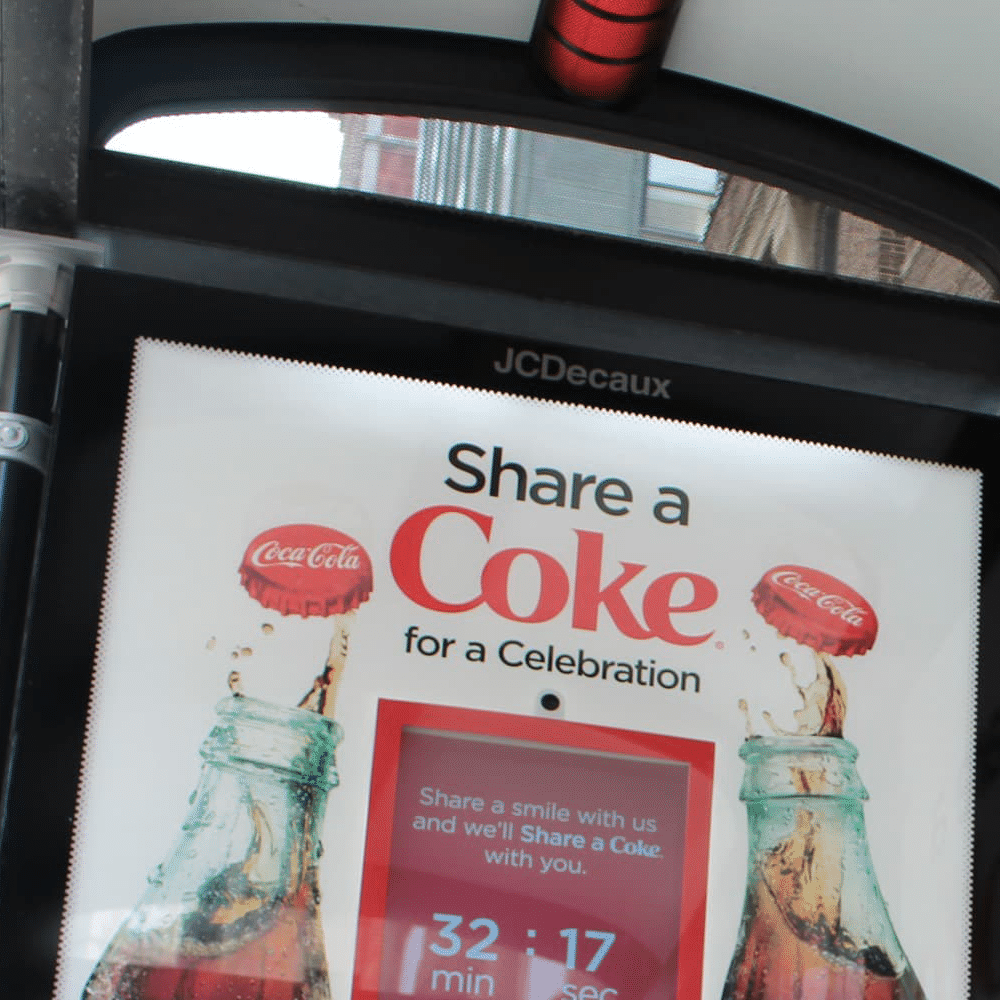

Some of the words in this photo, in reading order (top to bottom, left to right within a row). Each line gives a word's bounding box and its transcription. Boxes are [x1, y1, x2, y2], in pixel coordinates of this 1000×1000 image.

[493, 346, 671, 400] JCDecaux
[444, 442, 633, 517] Share
[652, 486, 691, 526] a
[389, 504, 718, 647] Coke
[404, 626, 457, 659] for
[464, 641, 487, 664] a
[498, 639, 701, 693] Celebration
[412, 814, 457, 834] and
[464, 820, 514, 841] we'll
[521, 823, 586, 850] Share
[591, 836, 605, 852] a
[609, 835, 662, 859] Coke
[419, 786, 485, 812] Share
[491, 800, 505, 815] a
[512, 801, 570, 823] smile
[577, 809, 626, 829] with
[633, 817, 657, 833] us
[484, 848, 533, 868] with
[540, 855, 586, 875] you.
[429, 912, 499, 961] 32
[559, 928, 617, 973] 17
[430, 966, 495, 996] min
